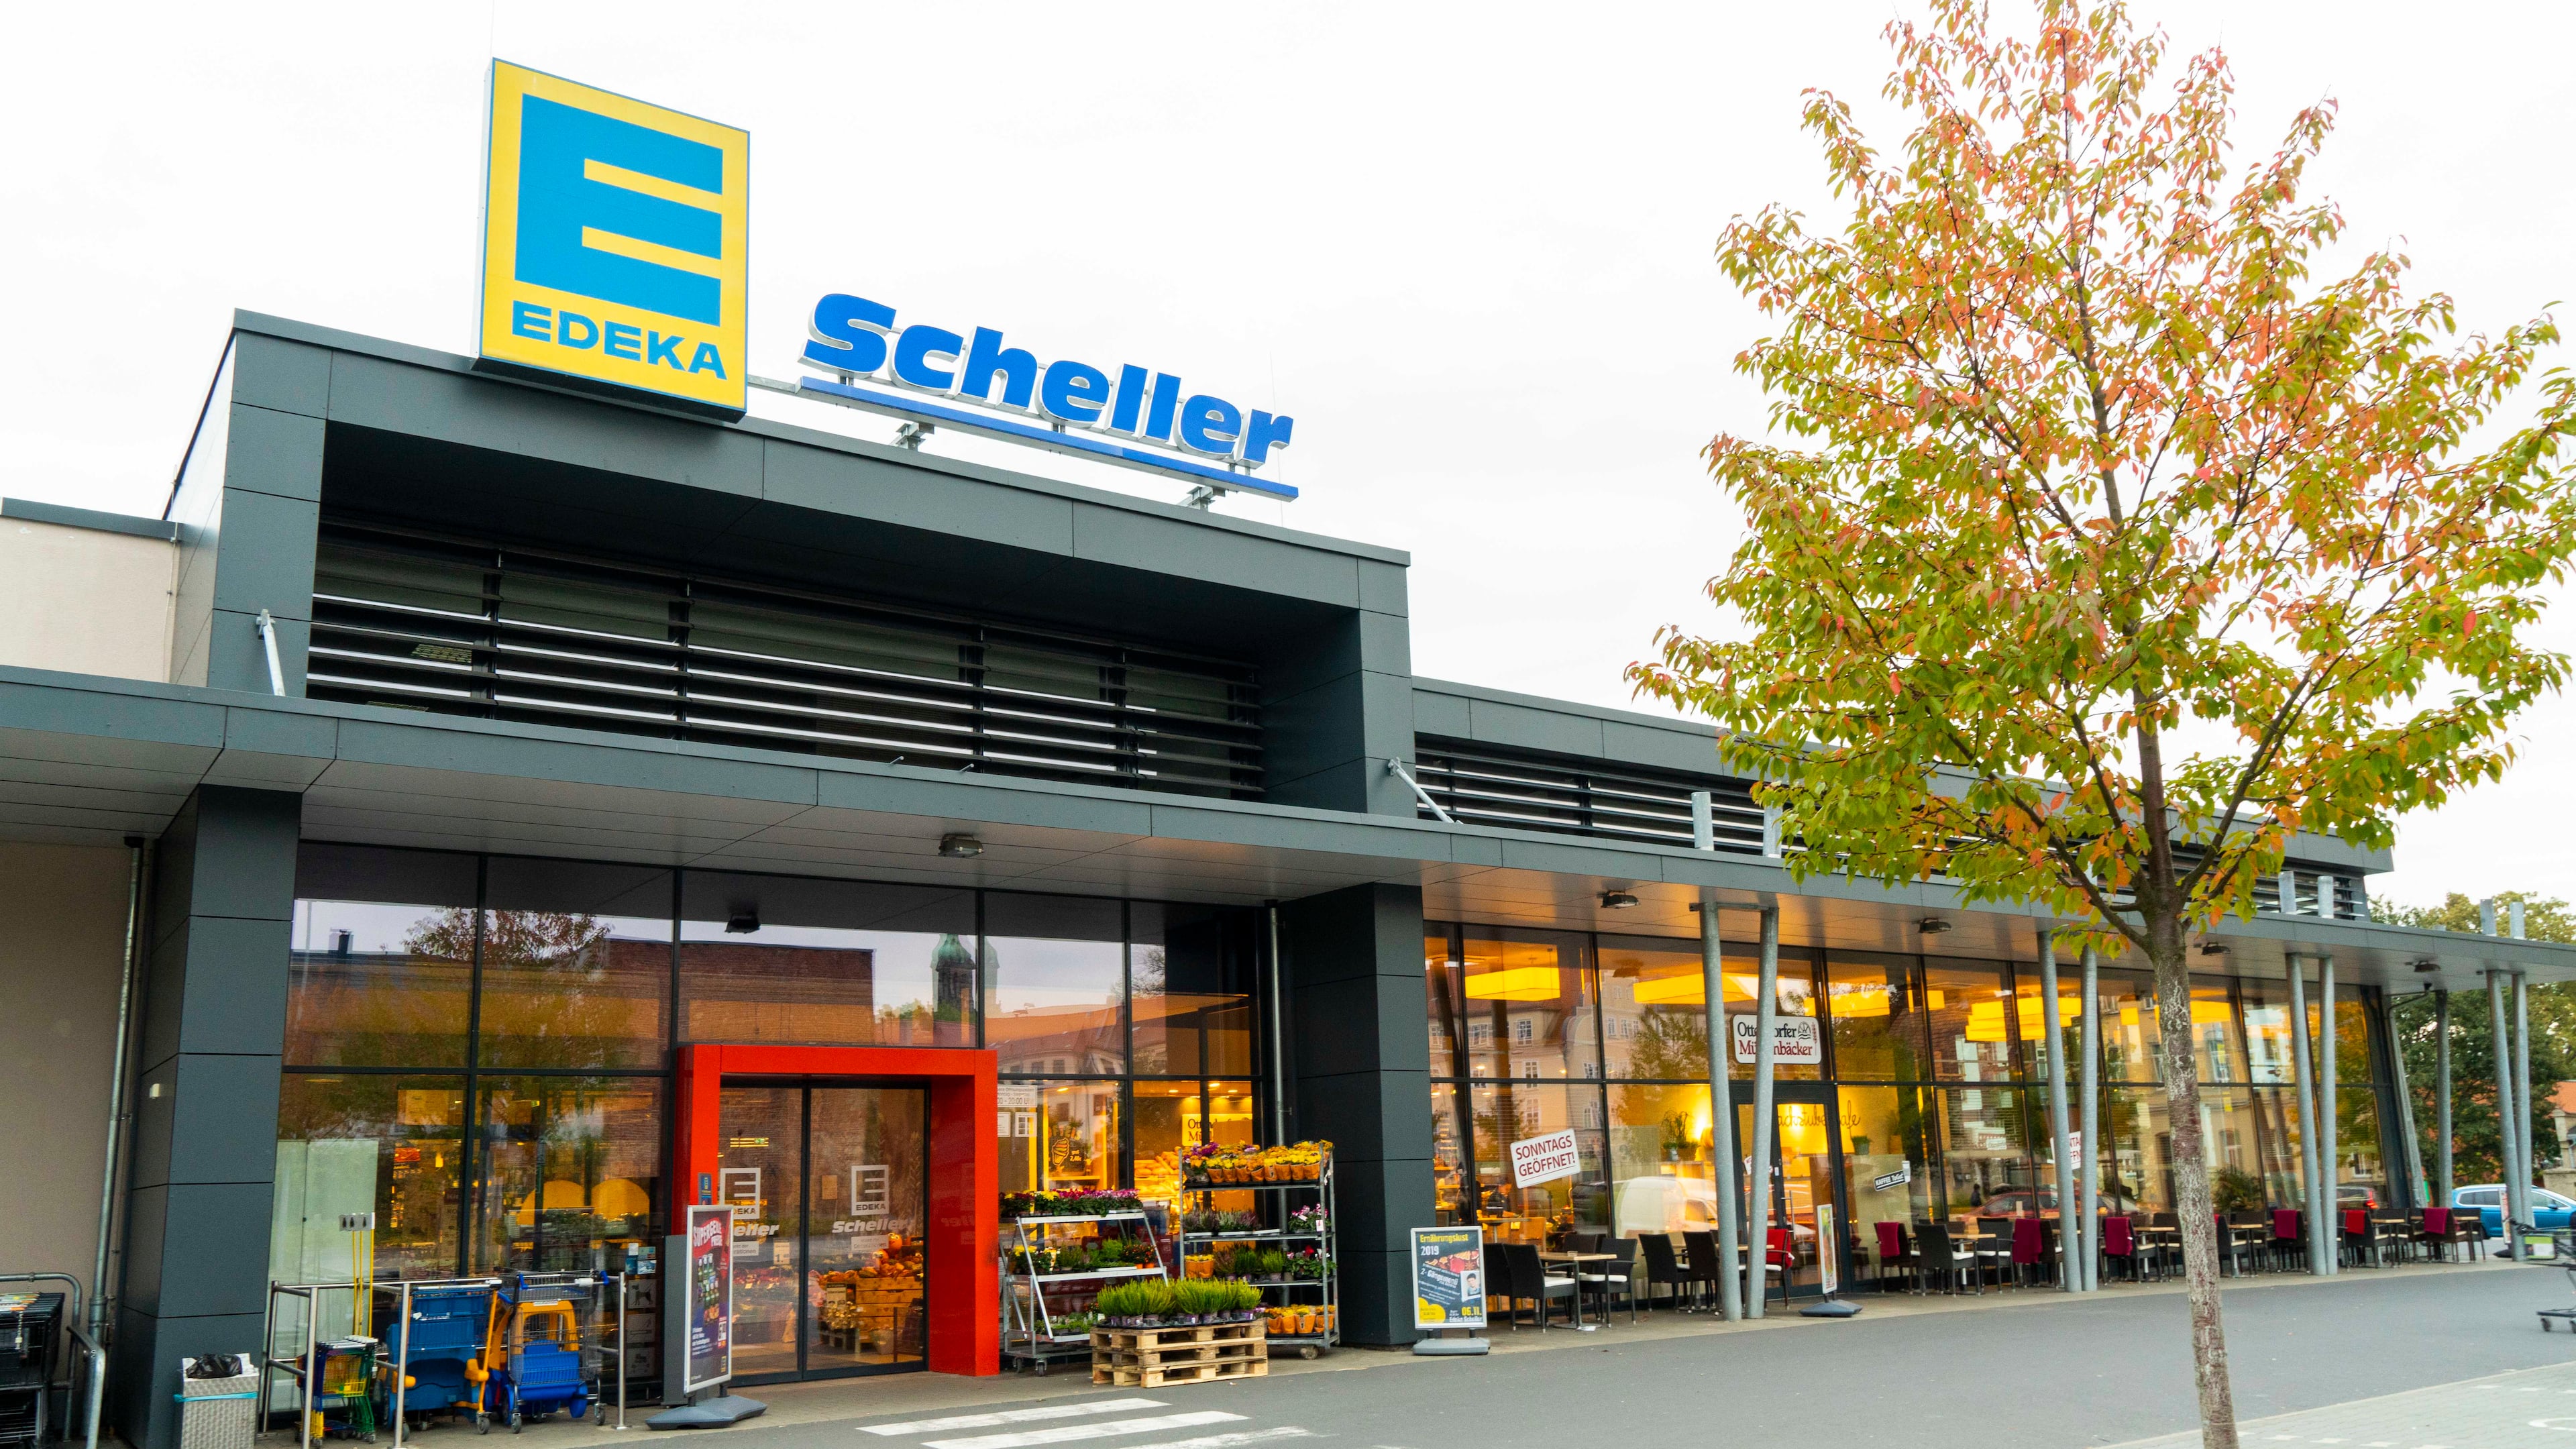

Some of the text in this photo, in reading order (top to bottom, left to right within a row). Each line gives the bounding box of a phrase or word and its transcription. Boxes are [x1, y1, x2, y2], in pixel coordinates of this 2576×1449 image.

[515, 93, 723, 327] E
[513, 300, 728, 380] EDEKA
[800, 293, 1293, 468] Scheller
[1737, 1022, 1796, 1038] Ottrfer
[1739, 1040, 1813, 1056] Münbäcker
[1048, 1125, 1083, 1140] OFTEIS
[1515, 1135, 1572, 1161] SONNTAGS
[1519, 1151, 1575, 1177] GEÖFFNET!
[1875, 1176, 1892, 1186] KAFFEE
[734, 1223, 780, 1236] eller
[832, 1218, 908, 1234] Scheller
[1419, 1234, 1468, 1243] Ernährungslust
[1421, 1246, 1440, 1256] 2019
[1461, 1306, 1482, 1316] 06.11.
